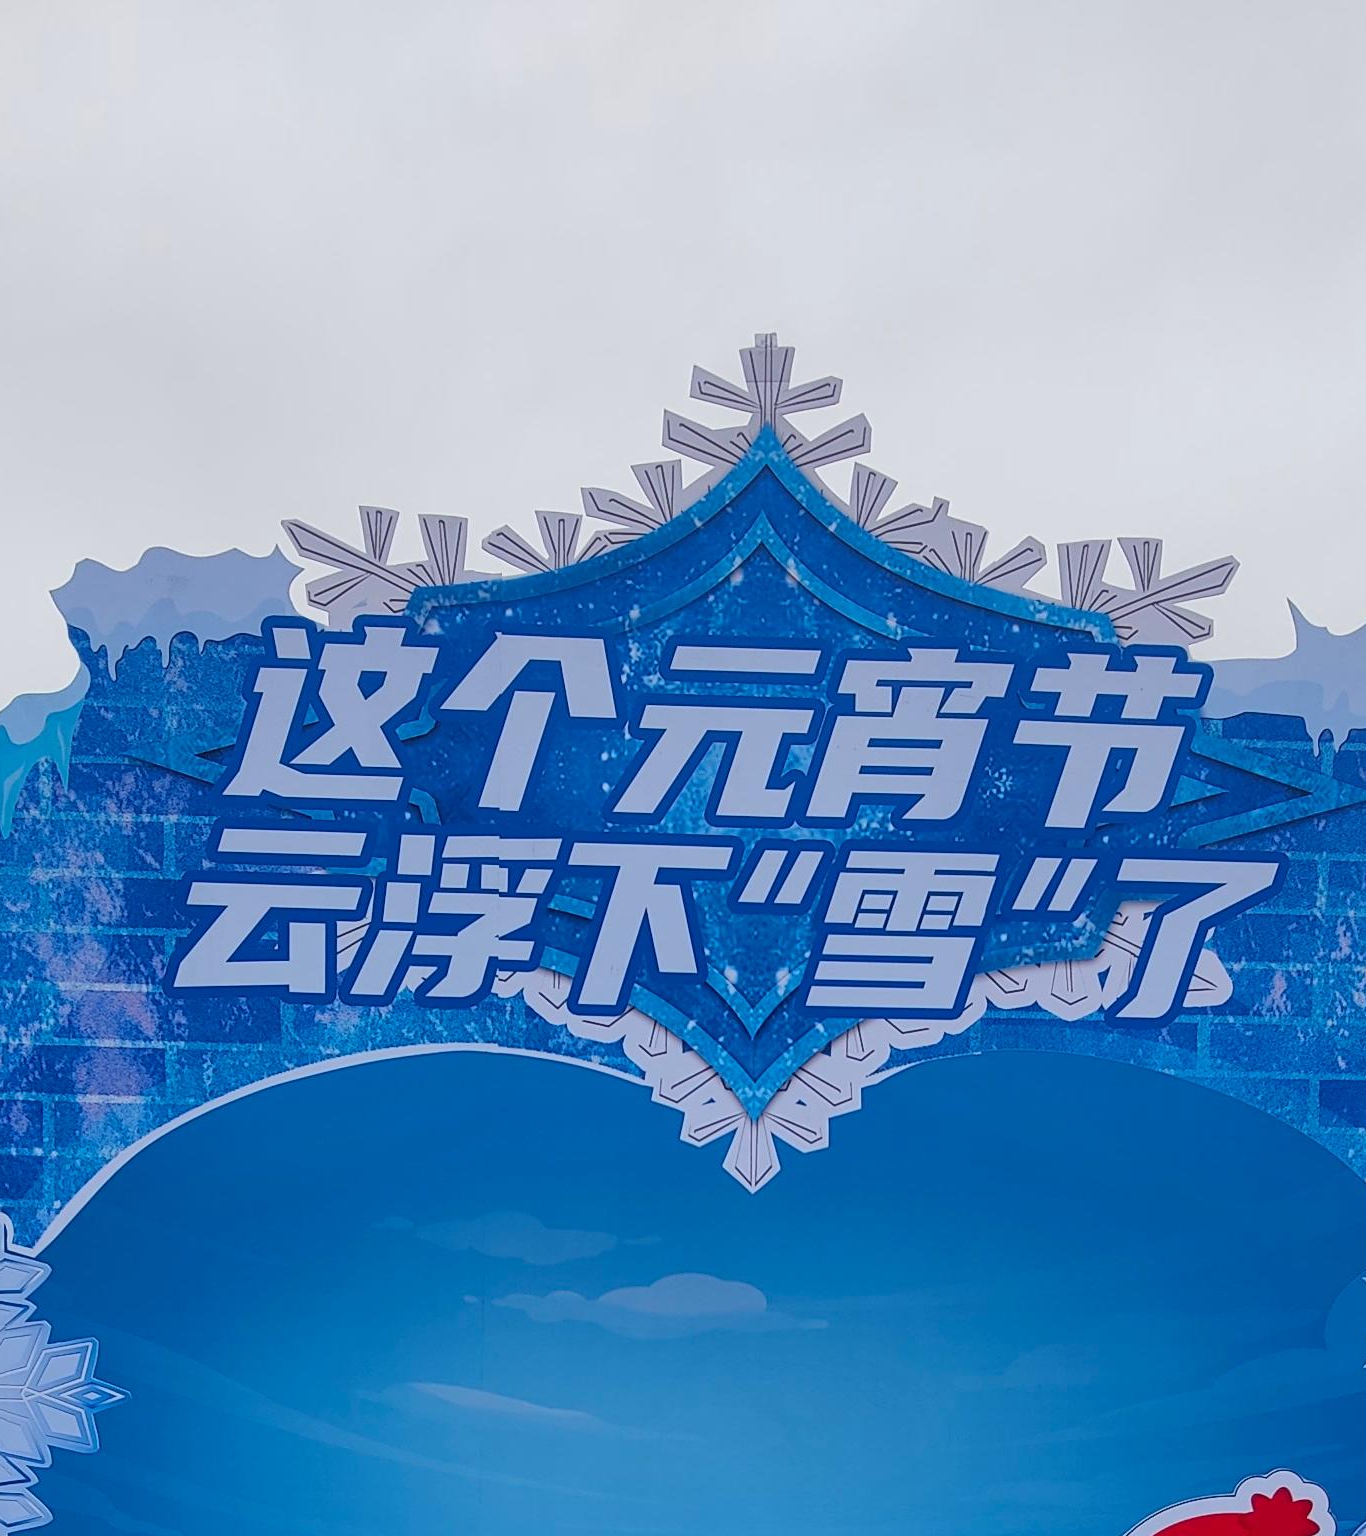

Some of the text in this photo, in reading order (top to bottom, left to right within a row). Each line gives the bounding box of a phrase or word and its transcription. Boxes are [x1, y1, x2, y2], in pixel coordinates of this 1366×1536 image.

[223, 627, 1203, 829] 这个元宵节
